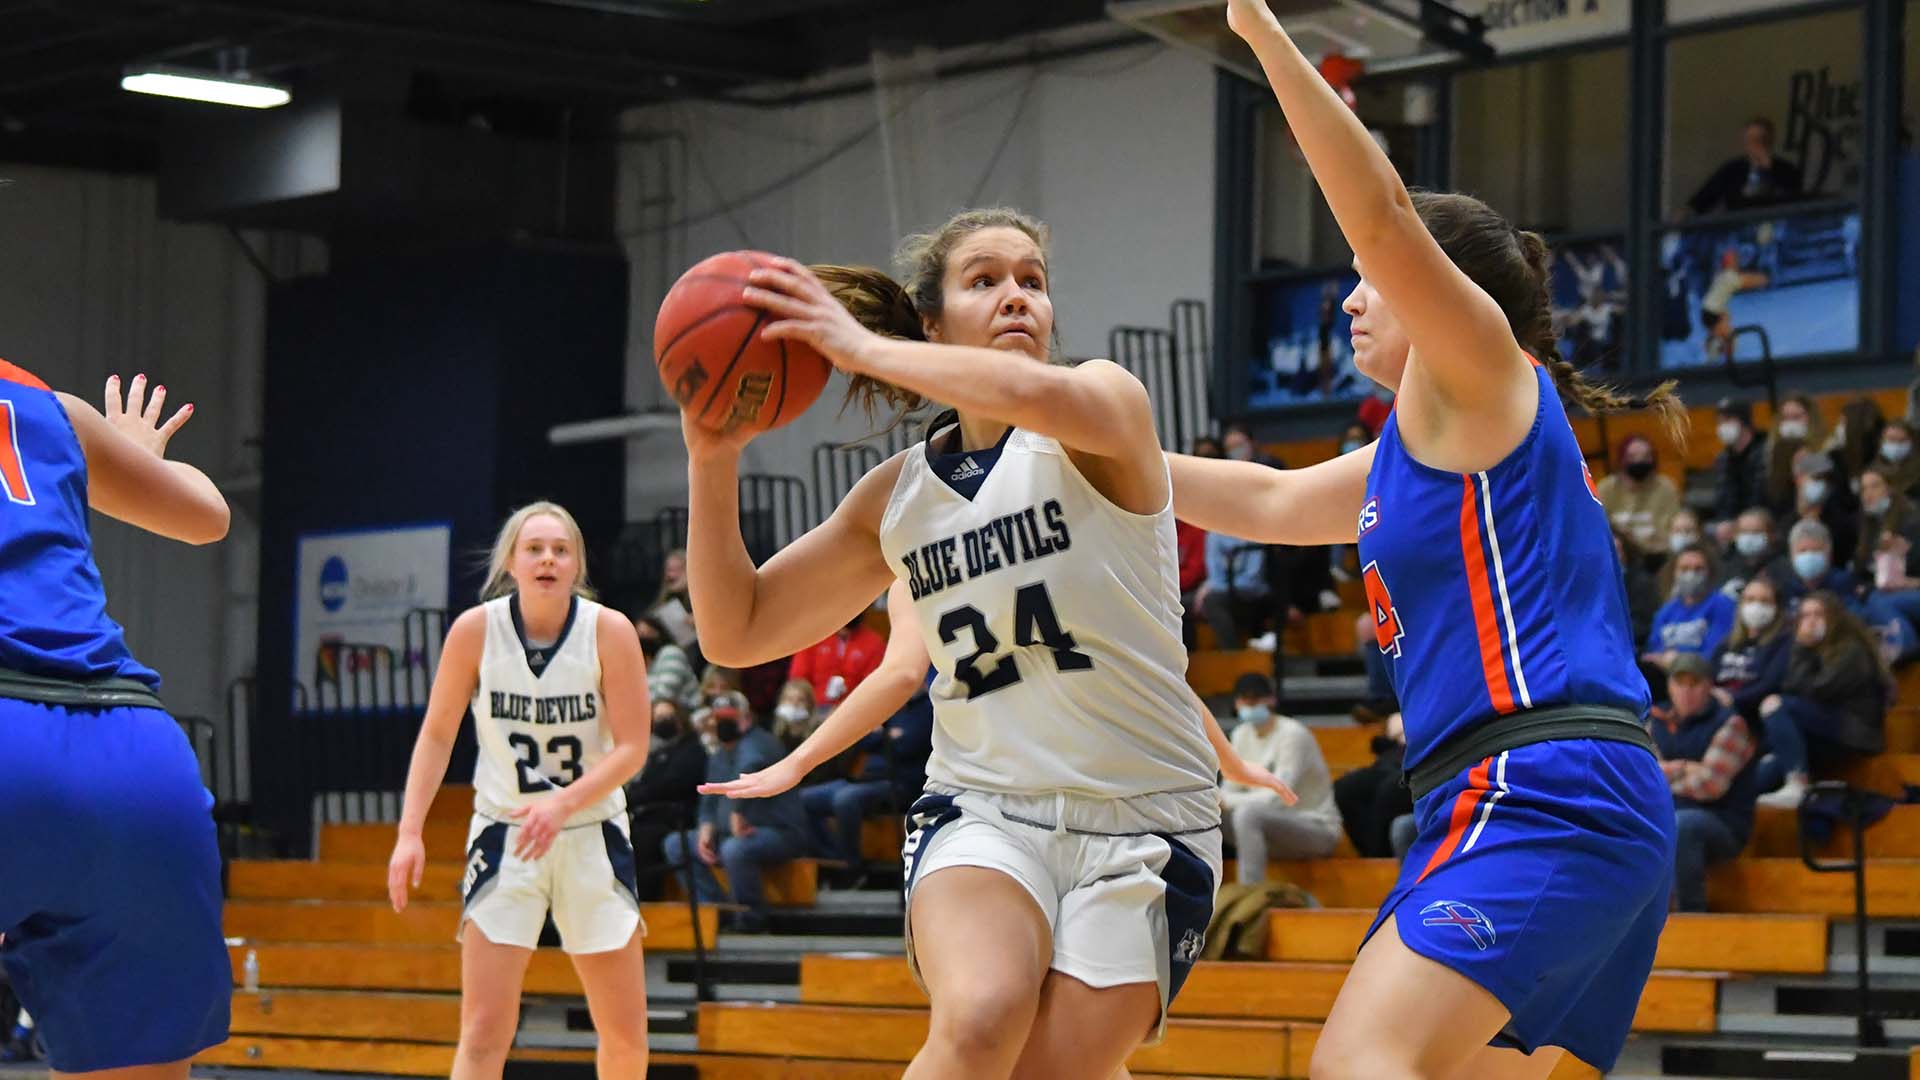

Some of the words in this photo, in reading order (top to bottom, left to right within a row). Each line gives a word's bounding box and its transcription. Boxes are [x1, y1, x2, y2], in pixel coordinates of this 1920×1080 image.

[951, 468, 985, 481] adidas
[902, 536, 963, 602] BLUE
[962, 498, 1073, 581] DEVILS
[938, 580, 1096, 704] 24
[490, 691, 531, 722] BLUE
[535, 693, 597, 725] DEVILS
[509, 731, 584, 795] 23
